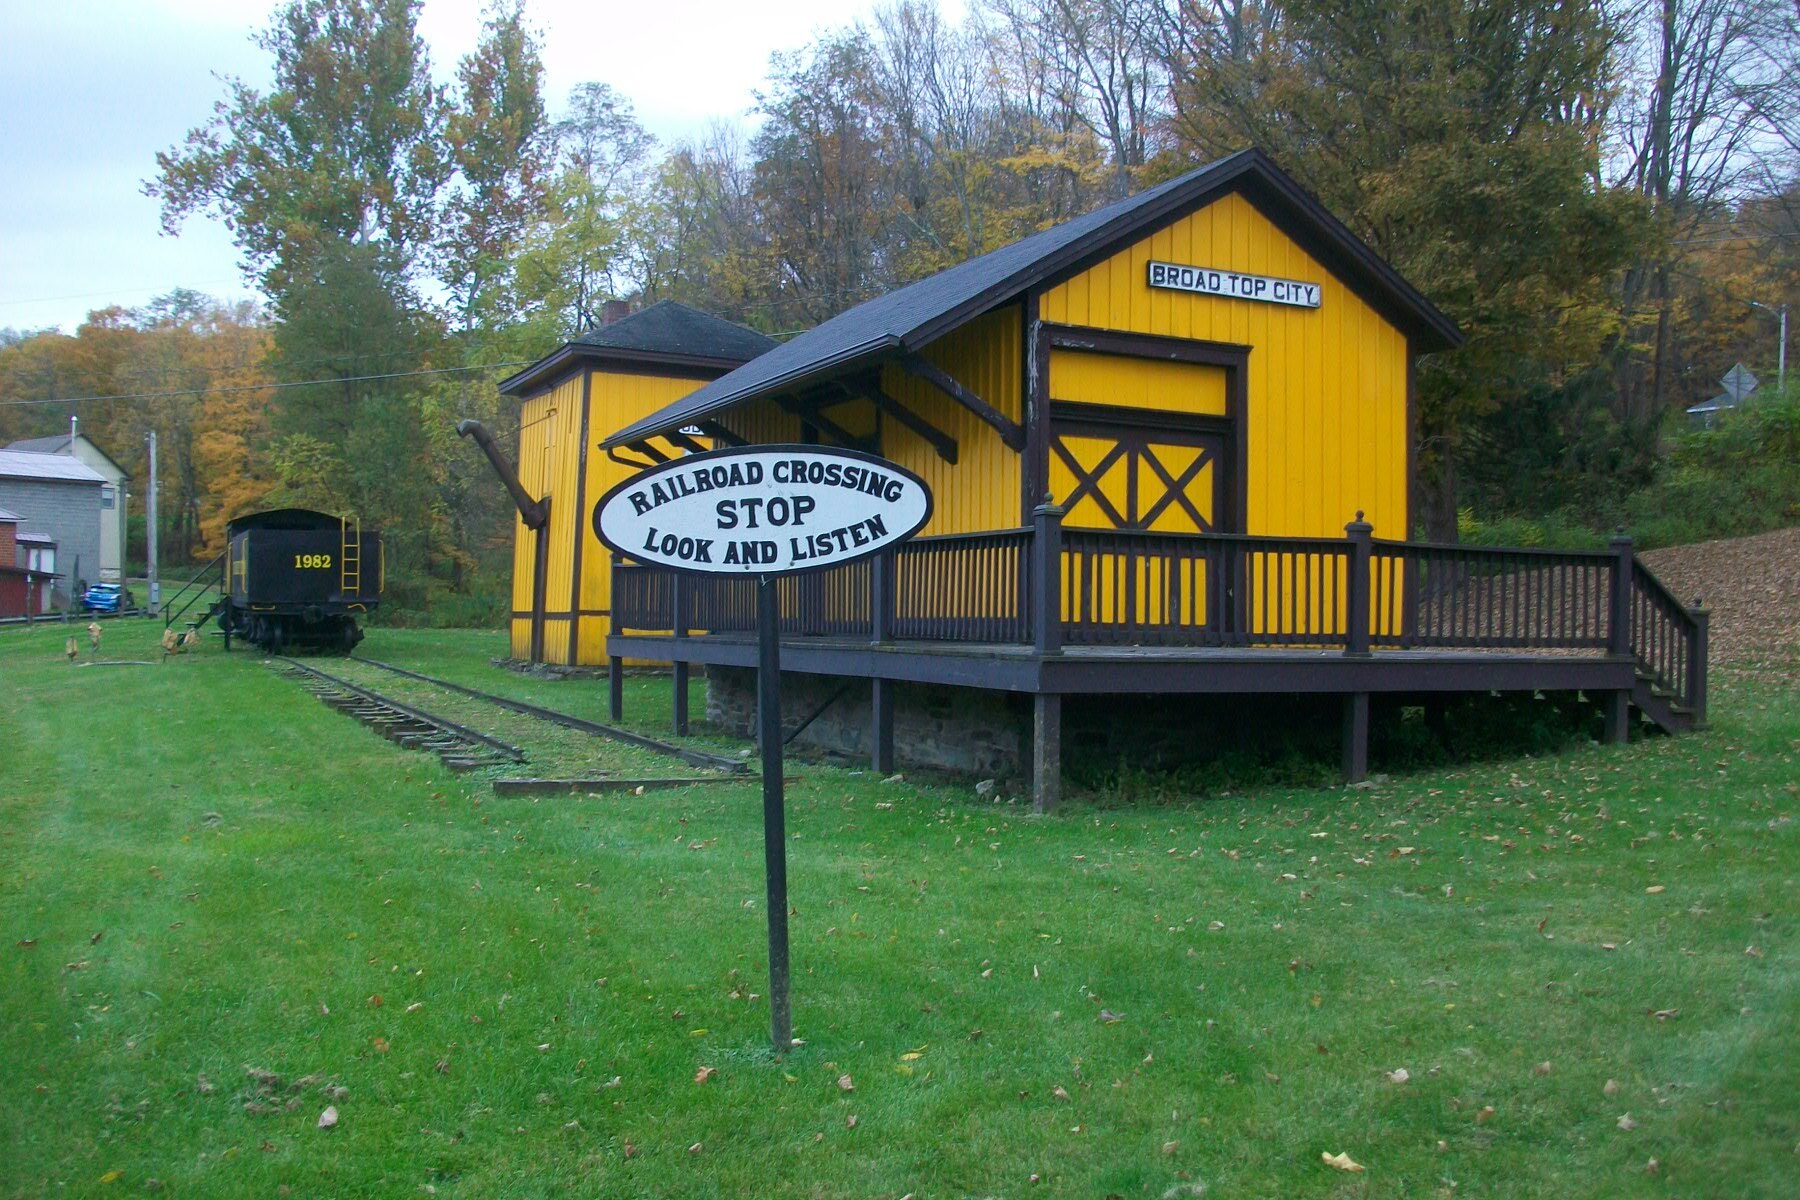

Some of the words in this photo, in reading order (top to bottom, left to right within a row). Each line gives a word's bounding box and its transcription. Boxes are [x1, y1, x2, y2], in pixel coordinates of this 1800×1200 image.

[1152, 265, 1221, 292] BROAD
[1228, 274, 1267, 297] TOP
[1273, 281, 1317, 305] CITY
[628, 460, 764, 516] RAILROAD
[772, 460, 904, 503] CROSSING
[717, 496, 816, 530] STOP
[643, 527, 714, 564] LOOK
[722, 541, 778, 565] AND
[790, 514, 889, 562] LISTEN
[294, 554, 332, 569] 1982
